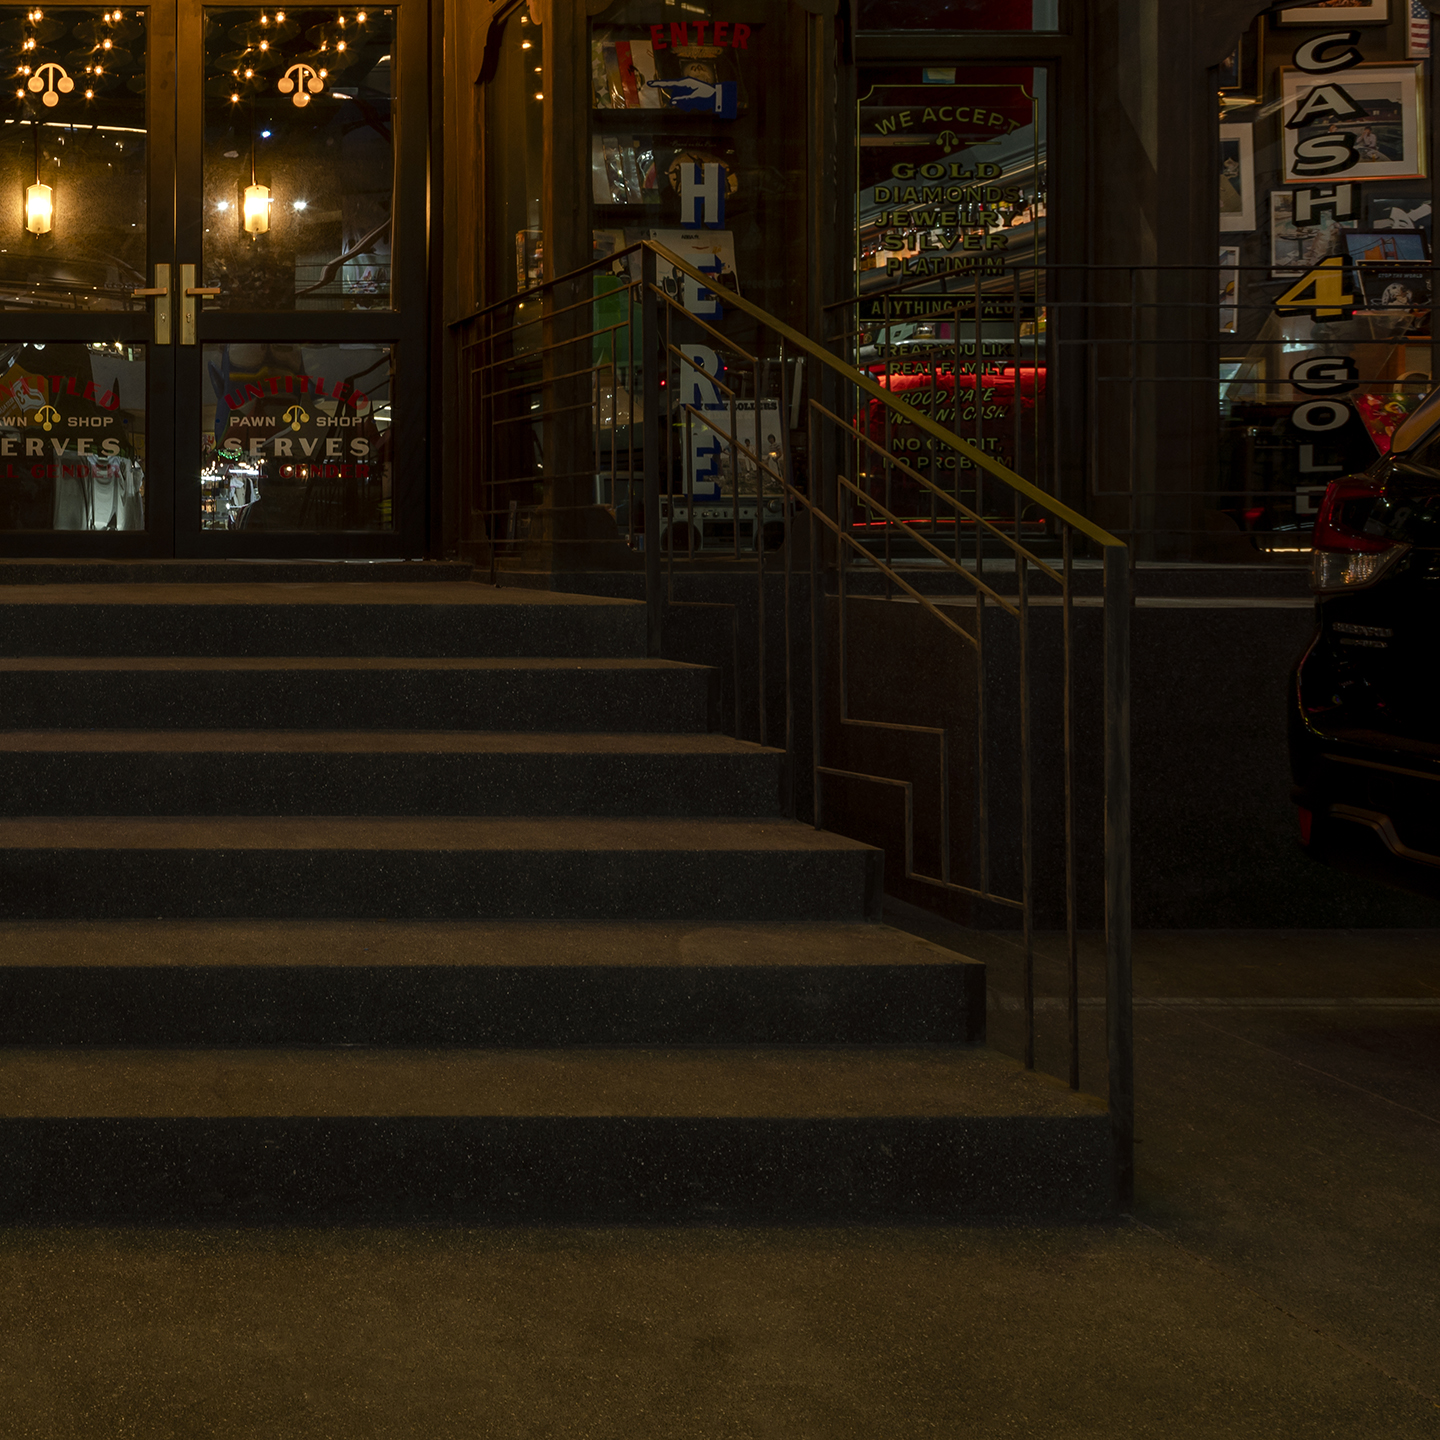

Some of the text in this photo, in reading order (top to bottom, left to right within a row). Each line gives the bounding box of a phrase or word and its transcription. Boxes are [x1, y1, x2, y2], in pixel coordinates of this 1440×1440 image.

[649, 20, 752, 51] ENTER
[874, 106, 1021, 136] WE ACCEPT
[1287, 30, 1368, 227] CASH
[891, 162, 1003, 180] GOLD
[873, 186, 1021, 205] DIAMONDS
[874, 210, 1023, 228] JEWELRY
[883, 234, 1010, 252] SILVER
[1273, 255, 1356, 323] 4
[980, 299, 1024, 316] ALU
[679, 161, 726, 502] HERE
[875, 343, 934, 357] TREAT
[224, 375, 368, 410] UNTITLED
[67, 416, 114, 427] SHOP
[230, 416, 362, 427] PAWN SHOP
[223, 437, 370, 457] SERVES
[893, 437, 921, 451] NO
[31, 464, 120, 478] GENDER
[918, 456, 1015, 469] PROBM
